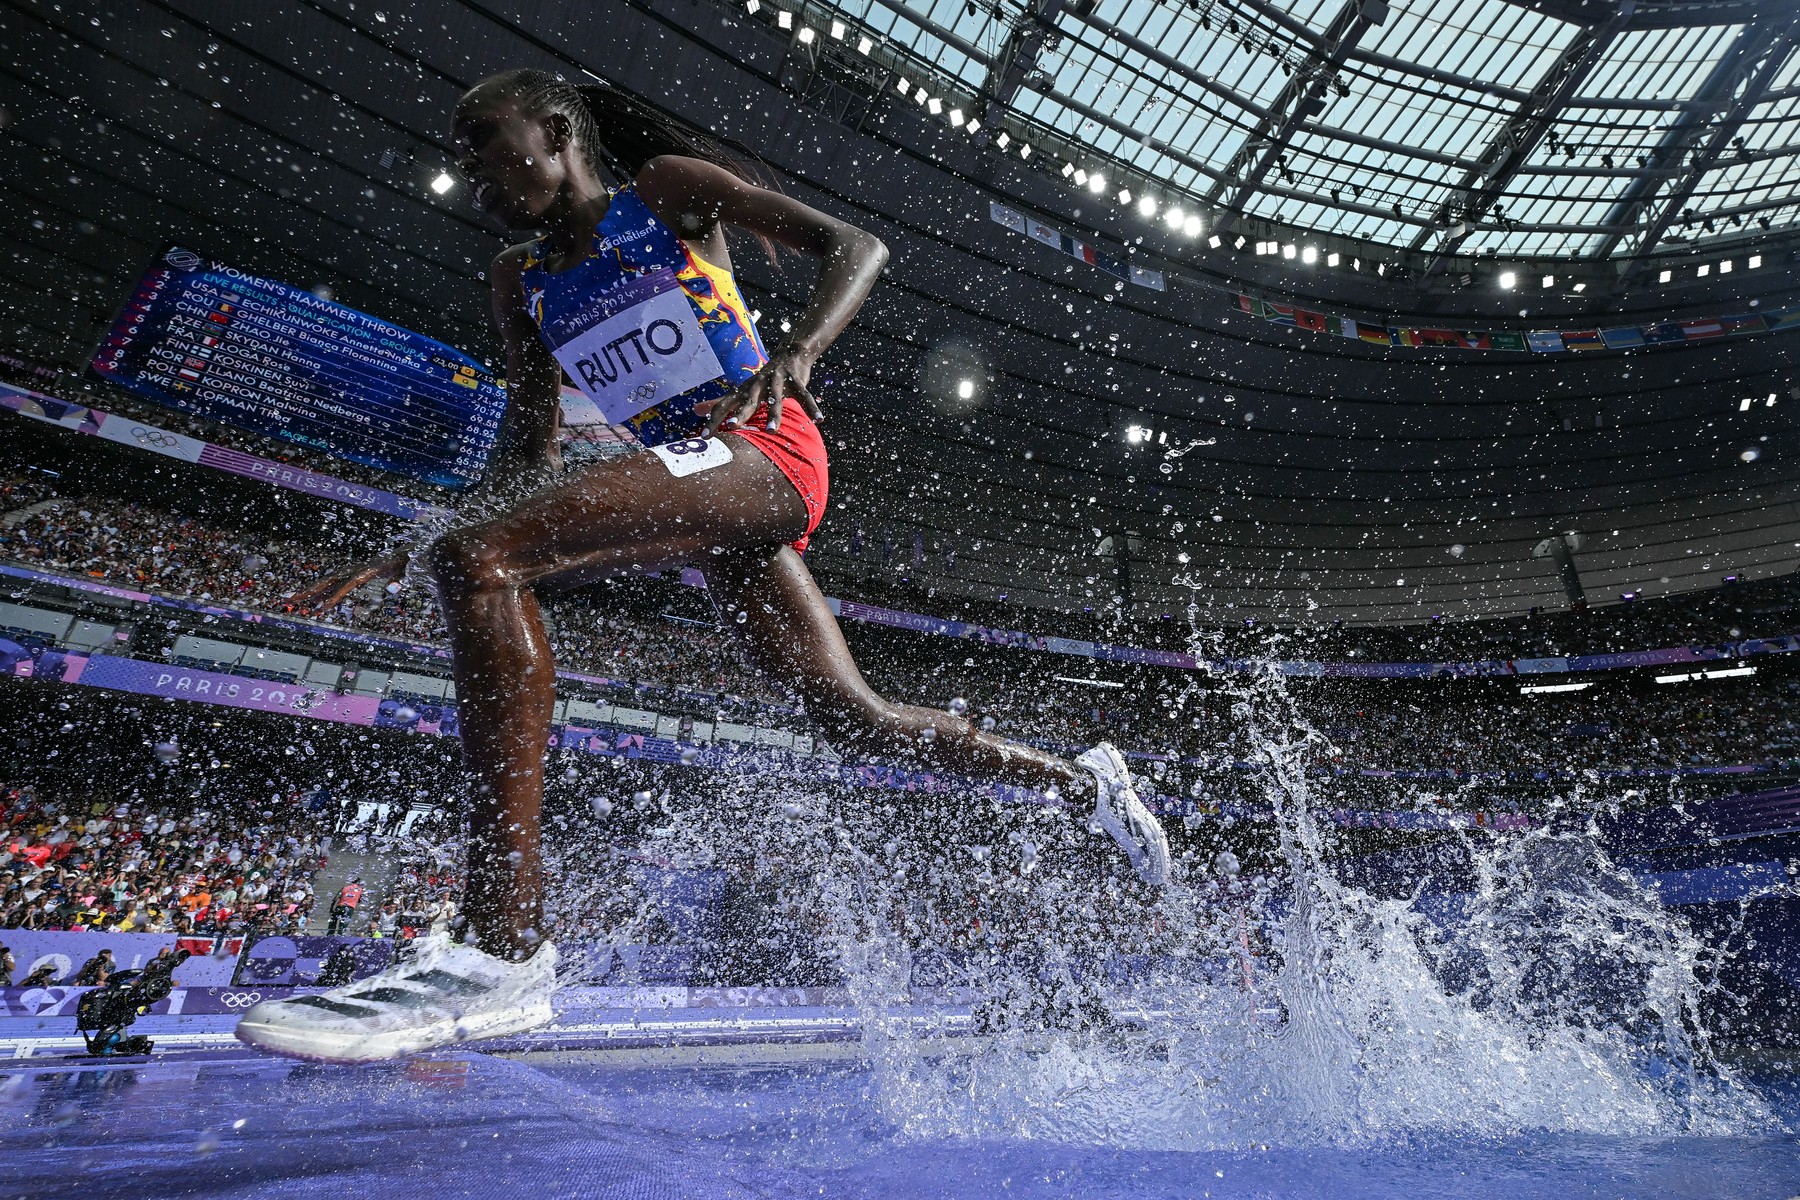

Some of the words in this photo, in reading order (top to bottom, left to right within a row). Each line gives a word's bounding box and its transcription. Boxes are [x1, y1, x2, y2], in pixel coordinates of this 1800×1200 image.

[612, 225, 657, 246] atletism
[203, 273, 230, 288] LIVE
[231, 283, 278, 306] RESULTS
[288, 304, 372, 339] QUALIFICATION
[380, 338, 416, 357] GROUP
[211, 260, 287, 296] WOMEN'S
[289, 291, 357, 323] HAMMER
[360, 316, 411, 341] THROW
[569, 308, 599, 331] PARIS
[602, 291, 634, 313] 2024
[128, 326, 138, 334] 6
[166, 337, 191, 351] FIN
[213, 353, 282, 381] KOSKINEN
[284, 376, 310, 390] Suvi
[135, 314, 145, 322] 5
[166, 325, 195, 340] FRA
[219, 342, 259, 361] LOGA
[262, 357, 291, 372] Rose
[141, 304, 152, 312] 4
[172, 315, 202, 329] AZE
[225, 330, 279, 355] SKYDAN
[281, 349, 322, 370] Hanna
[470, 415, 498, 429] 69.58
[148, 292, 158, 300] 3
[176, 301, 208, 318] CHN
[230, 320, 270, 338] ZHAO
[272, 335, 290, 347] Jie
[474, 404, 501, 418] 70.78
[154, 281, 165, 289] 2
[182, 290, 214, 307] ROU
[237, 310, 296, 336] GHELBER
[341, 346, 398, 372] Florentina
[477, 394, 505, 409] 71.42
[161, 270, 170, 279] 1
[191, 280, 218, 296] USA
[242, 299, 339, 339] ECHIKUNWOKE
[480, 384, 507, 399] 73.52
[575, 319, 683, 394] RUTTO
[108, 361, 118, 369] 9
[138, 370, 171, 387] SWE
[195, 388, 257, 412] LOFMAN
[260, 408, 293, 424] Thea
[114, 349, 125, 358] 8
[146, 359, 176, 375] POL
[201, 376, 261, 400] KOPRON
[263, 396, 317, 419] Malwina
[456, 456, 486, 470] 65.39
[122, 337, 132, 345] 7
[149, 346, 184, 362] NOR
[206, 365, 256, 386] LLANO
[258, 380, 310, 403] Beatrice
[313, 399, 371, 424] Nedberge
[460, 446, 488, 460] 66.11
[280, 429, 309, 443] PAGE
[309, 437, 329, 449] 1/2
[252, 462, 316, 488] PARIS
[323, 482, 376, 504] 2024
[867, 609, 901, 622] PARIS
[156, 673, 240, 698] PARIS
[1592, 655, 1626, 665] PARIS
[1631, 651, 1664, 664] 2024
